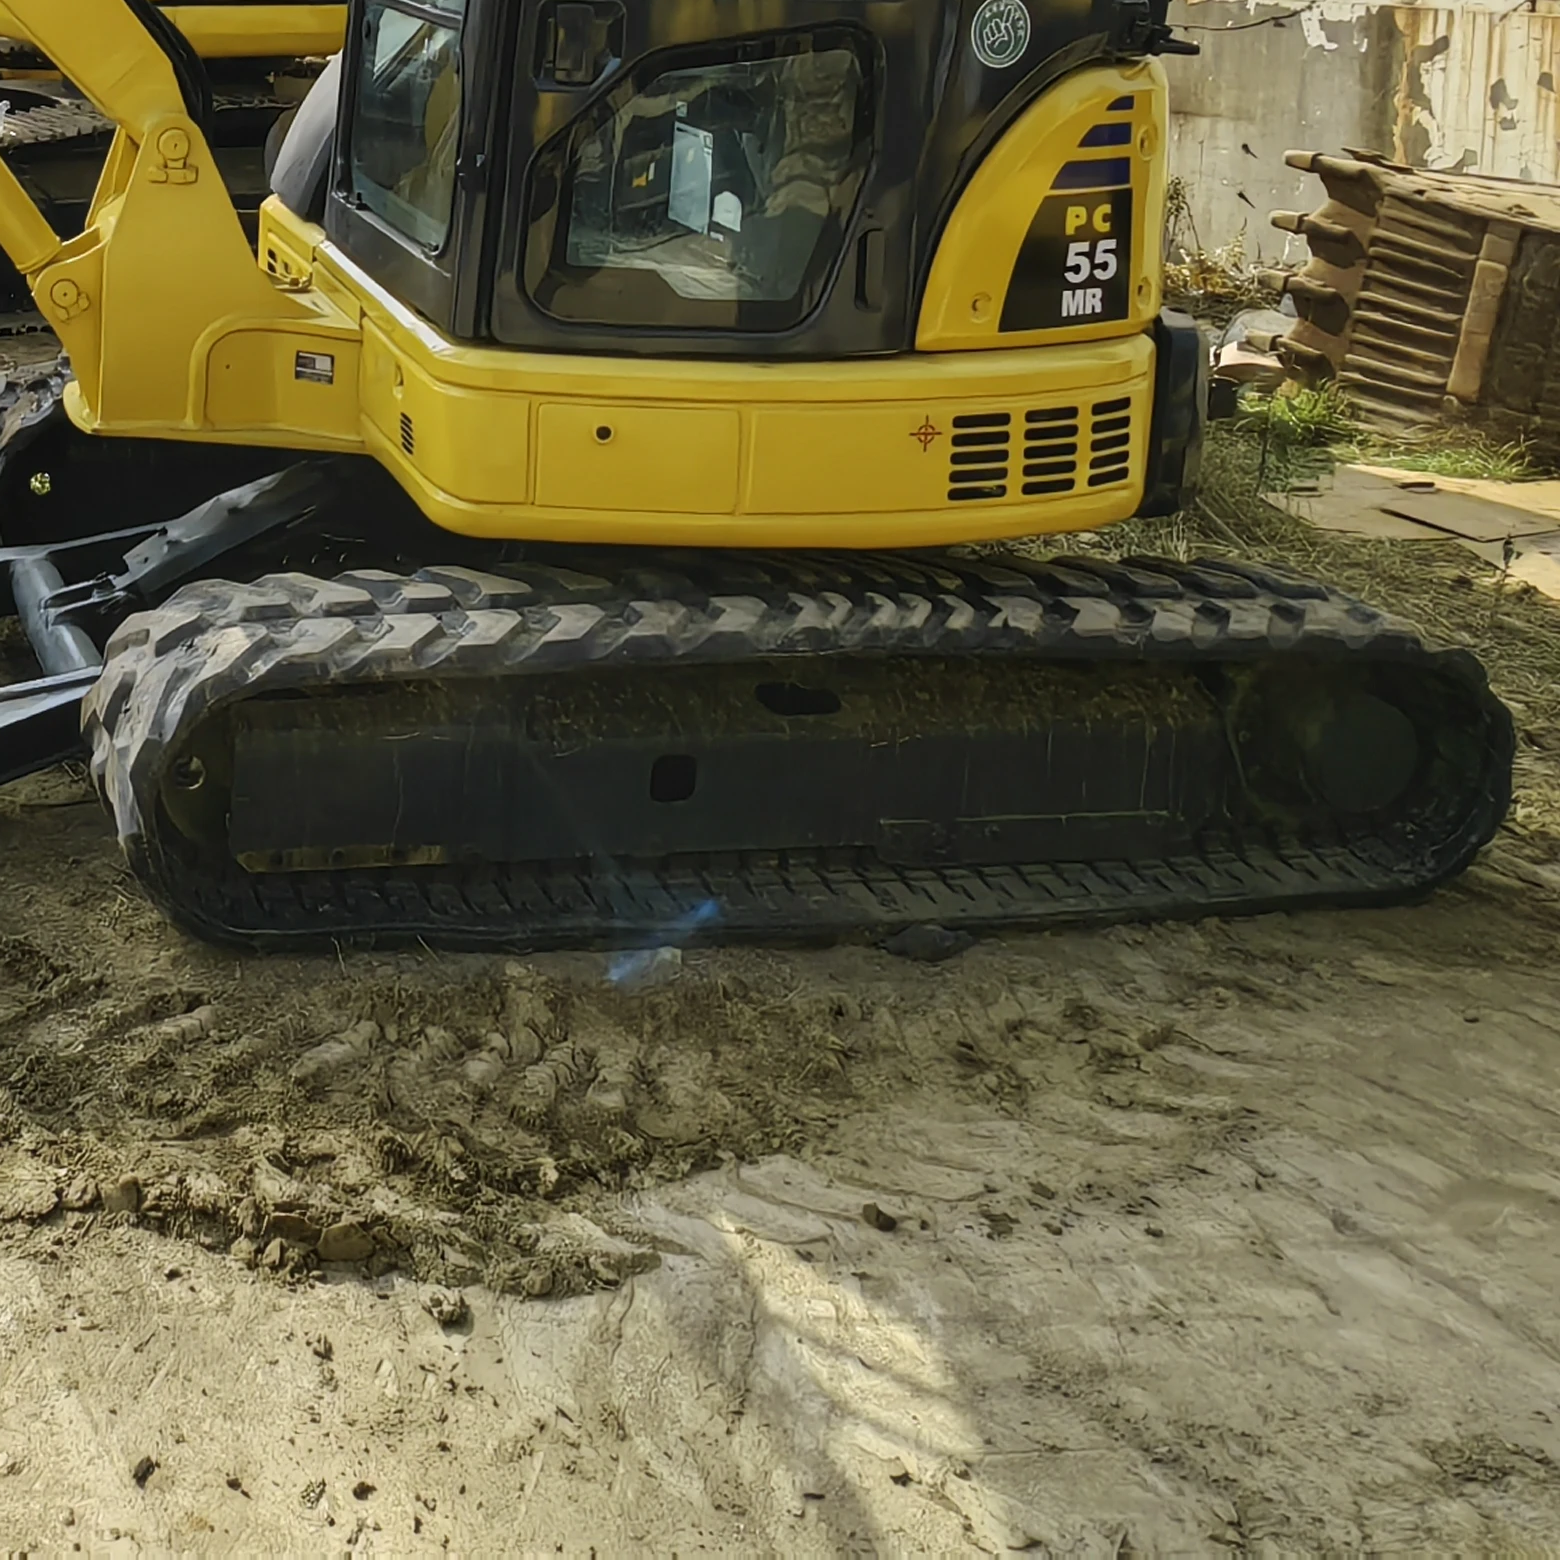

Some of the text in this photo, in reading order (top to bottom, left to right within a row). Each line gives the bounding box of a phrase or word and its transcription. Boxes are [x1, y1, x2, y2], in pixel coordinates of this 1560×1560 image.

[1064, 203, 1112, 236] PC
[1063, 238, 1118, 284] 55
[1060, 287, 1103, 318] MR
